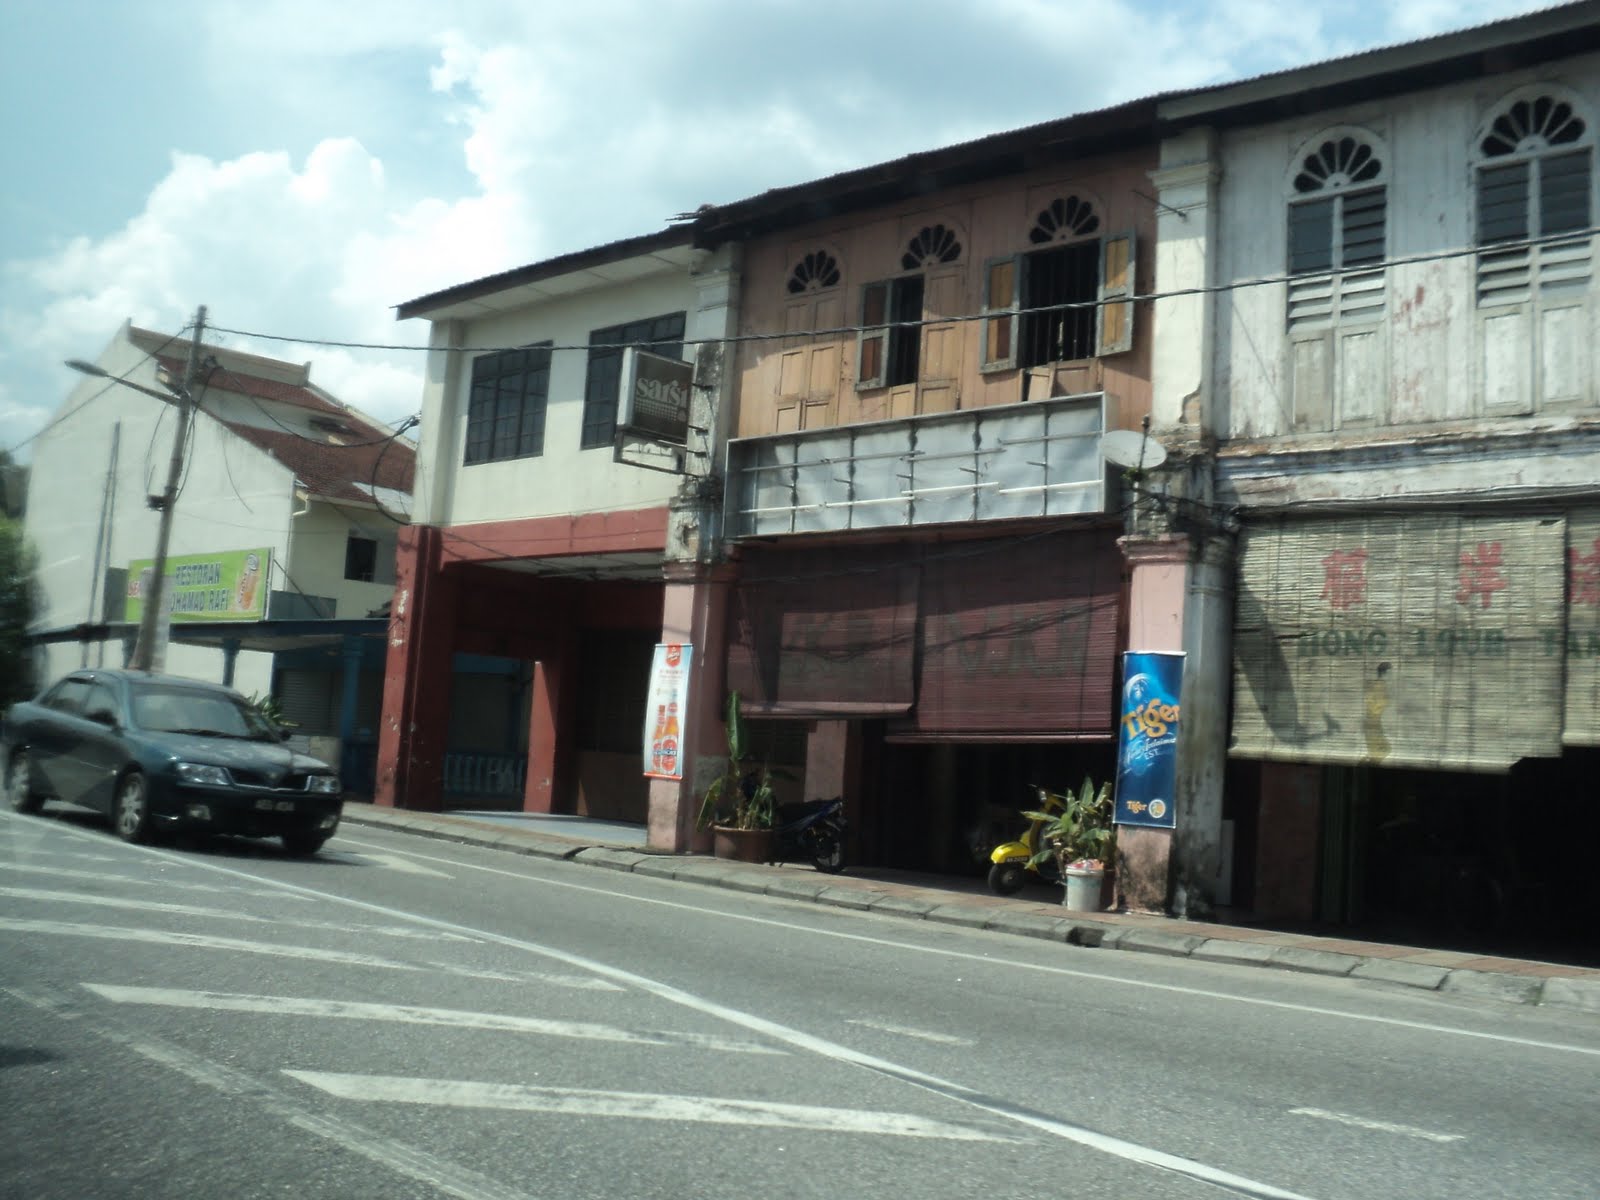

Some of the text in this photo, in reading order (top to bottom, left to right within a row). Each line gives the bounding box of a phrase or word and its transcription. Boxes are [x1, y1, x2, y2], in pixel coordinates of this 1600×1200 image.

[175, 562, 221, 586] RESTORAN
[1122, 698, 1180, 738] Tiger
[1126, 800, 1147, 814] Tiger
